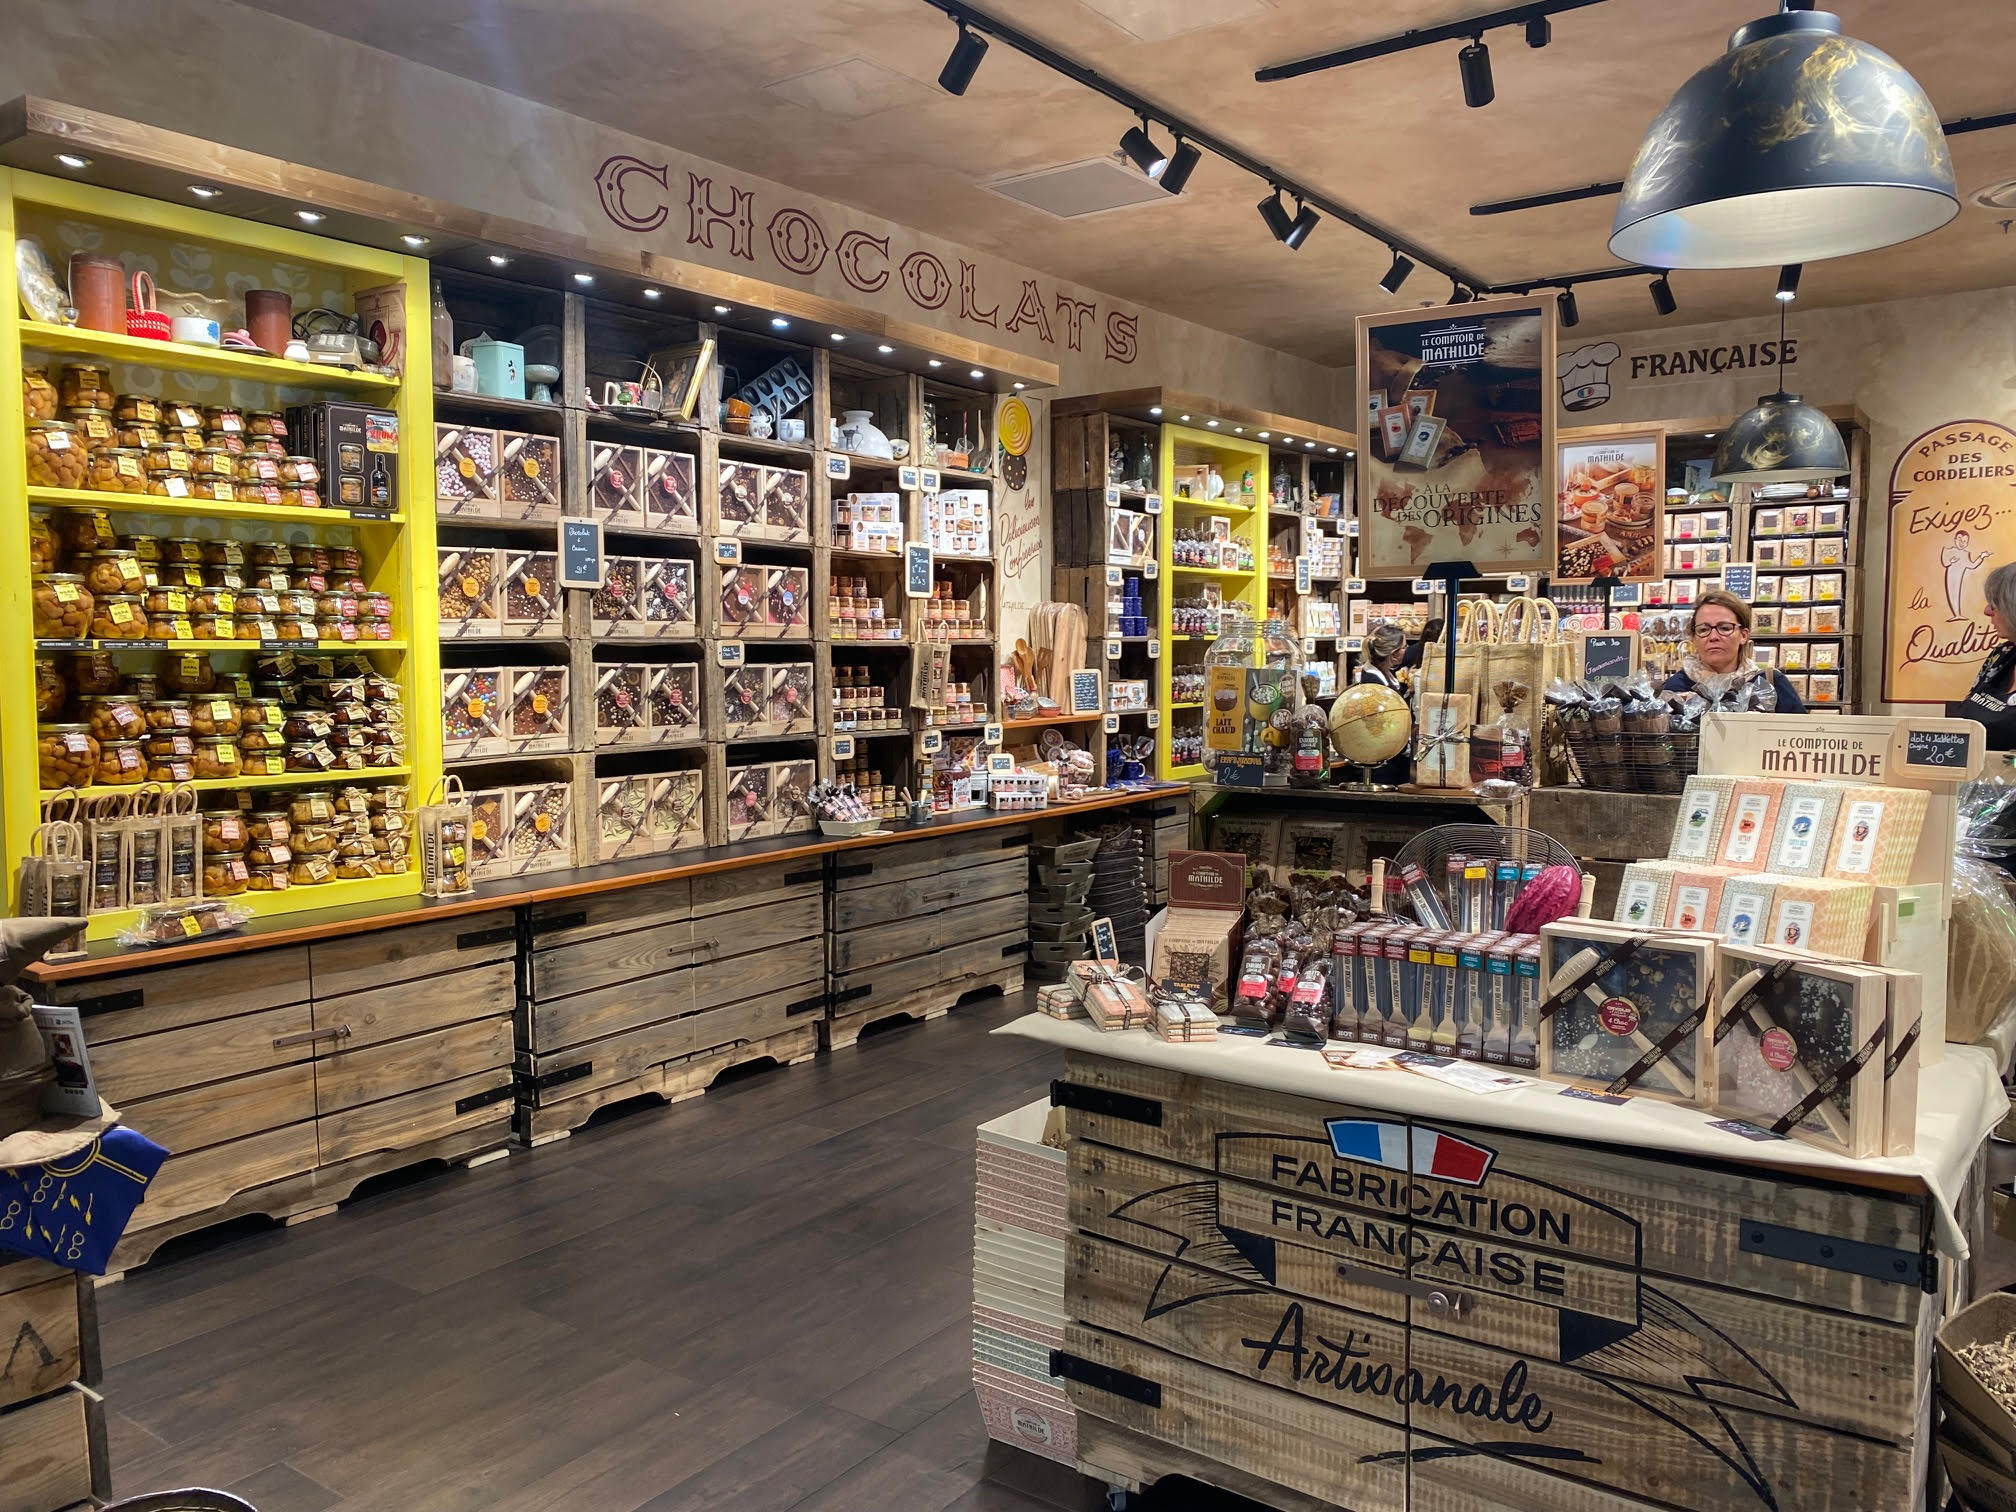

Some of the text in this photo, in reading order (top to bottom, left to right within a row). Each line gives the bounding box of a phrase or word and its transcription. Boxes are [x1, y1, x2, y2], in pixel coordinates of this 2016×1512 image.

[594, 154, 1139, 364] CHOCOLATS
[1430, 333, 1474, 346] COMPTOIR
[1476, 333, 1484, 341] DE
[1422, 342, 1485, 361] MATHILDE
[1631, 339, 1798, 379] FRANÇAISE
[1918, 431, 2014, 459] PASSAGE
[1587, 453, 1625, 463] MATHILDE
[1948, 452, 1982, 464] DES
[1913, 464, 2015, 482] CORDELIERS
[1435, 483, 1451, 493] LA
[1373, 489, 1506, 513] DÉCOUVERTE
[1397, 502, 1542, 528] DES ORIGINES
[1907, 587, 1932, 611] la
[1216, 718, 1232, 726] LAIT
[1778, 737, 1863, 751] LE COMPTOIR DE
[1925, 733, 1931, 742] 4
[1925, 745, 1956, 764] 20€
[1762, 750, 1881, 776] MATHILDE
[1188, 875, 1223, 884] MATHILDE
[1362, 1032, 1378, 1040] HOT
[1386, 1036, 1401, 1044] HOT
[1411, 1040, 1426, 1048] HOT
[1435, 1045, 1452, 1053] HOT
[1461, 1048, 1477, 1056] HOT
[1487, 1052, 1503, 1061] HOT
[1514, 1055, 1530, 1064] HOT
[1272, 1153, 1571, 1245] FABRICATION
[1272, 1200, 1566, 1297] FRANÇAISE
[1241, 1302, 1553, 1433] Artisanale
